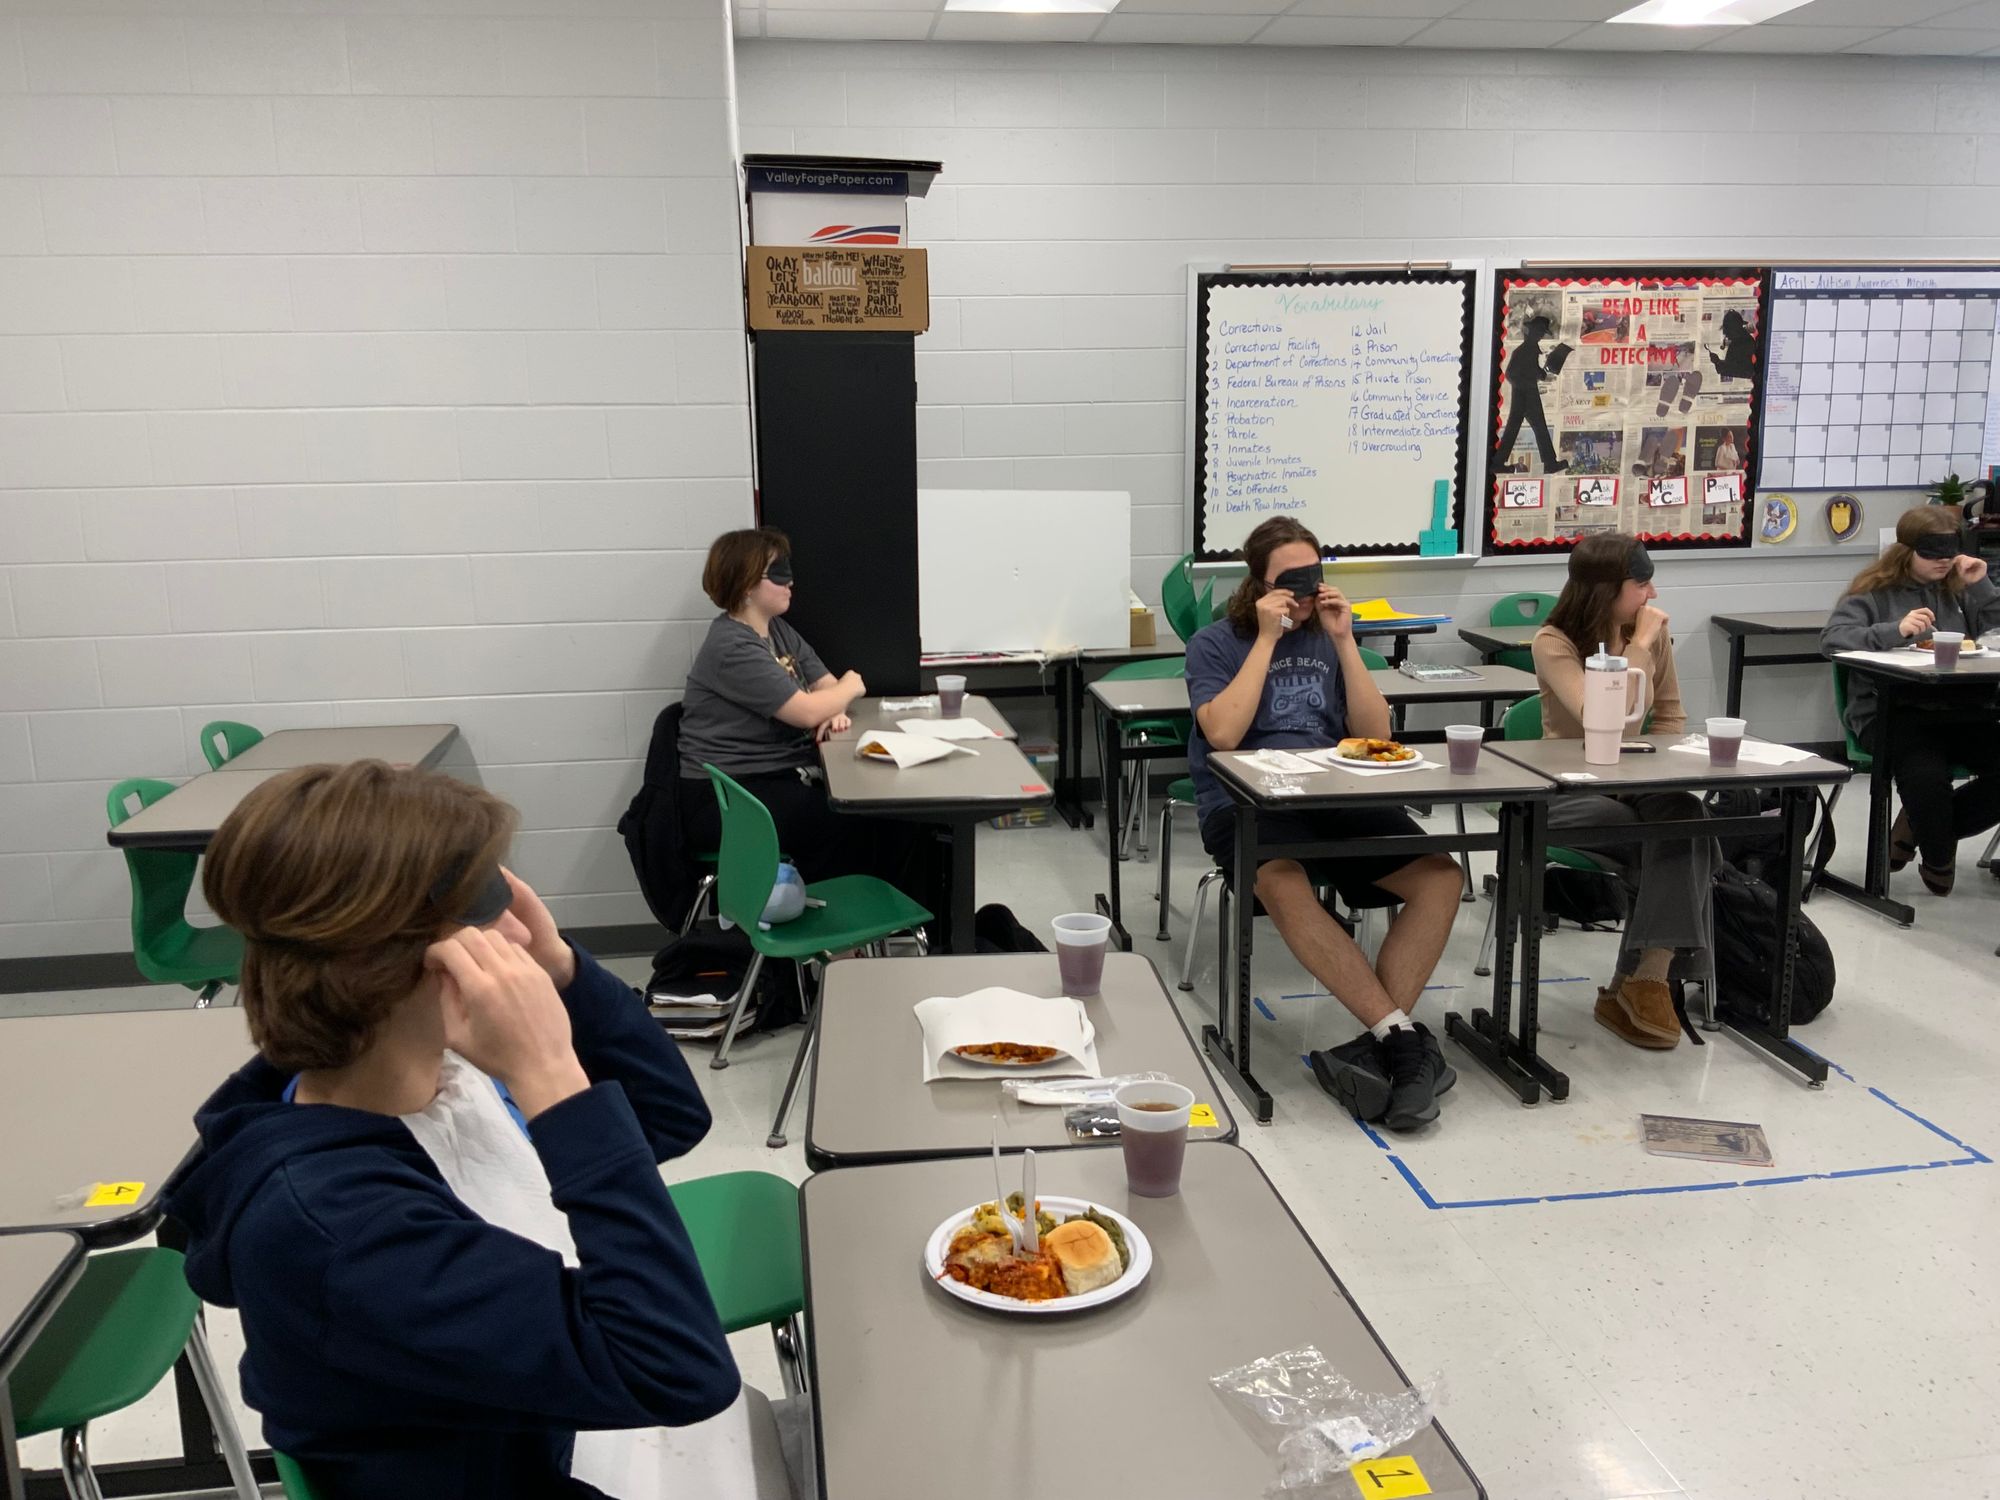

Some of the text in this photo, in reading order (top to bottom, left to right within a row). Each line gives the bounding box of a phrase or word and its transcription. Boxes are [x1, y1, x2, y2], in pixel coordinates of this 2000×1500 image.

[766, 172, 894, 187] ValleyForgePaper.com
[1781, 274, 1808, 289] April
[1817, 274, 1851, 288] Autism
[1275, 292, 1385, 315] Vocabulary
[1602, 298, 1680, 316] READ LIKE
[1219, 320, 1282, 336] Corrections
[1351, 322, 1387, 337] 12 Jail
[1636, 324, 1647, 342] A
[1225, 340, 1281, 354] Correctional
[1287, 336, 1320, 357] Facility
[1351, 339, 1398, 355] 13 Prison
[1211, 354, 1347, 373] 2 Department of Corrections
[1600, 346, 1679, 367] DETECTIVE
[1365, 355, 1419, 375] Community
[1211, 377, 1220, 390] 3
[1227, 375, 1262, 389] Federal
[1265, 374, 1298, 388] Bureau
[1302, 375, 1314, 388] of
[1351, 369, 1431, 385] 15 Private Prison
[1211, 396, 1298, 409] 4 Incarceration
[1350, 387, 1449, 409] 16 Community Service
[1211, 411, 1275, 426] 5 Probation
[1348, 406, 1358, 419] 17
[1361, 404, 1410, 421] Graduated
[1224, 425, 1258, 439] Parole
[1348, 424, 1358, 437] 18
[1361, 423, 1421, 437] Intermediate
[1211, 443, 1271, 454] 7 Inmates
[1348, 441, 1358, 454] 19
[1212, 454, 1302, 468] 8 Juvenile Inmates
[1212, 467, 1317, 486] 9 Psychiatric Inmates
[1211, 487, 1219, 498] 10
[1246, 483, 1288, 495] Offenders
[1706, 478, 1729, 493] Prove
[1212, 503, 1220, 513] 11
[1226, 500, 1250, 513] Death
[1272, 497, 1307, 510] Inmates
[1269, 657, 1330, 674] NICE BEACH
